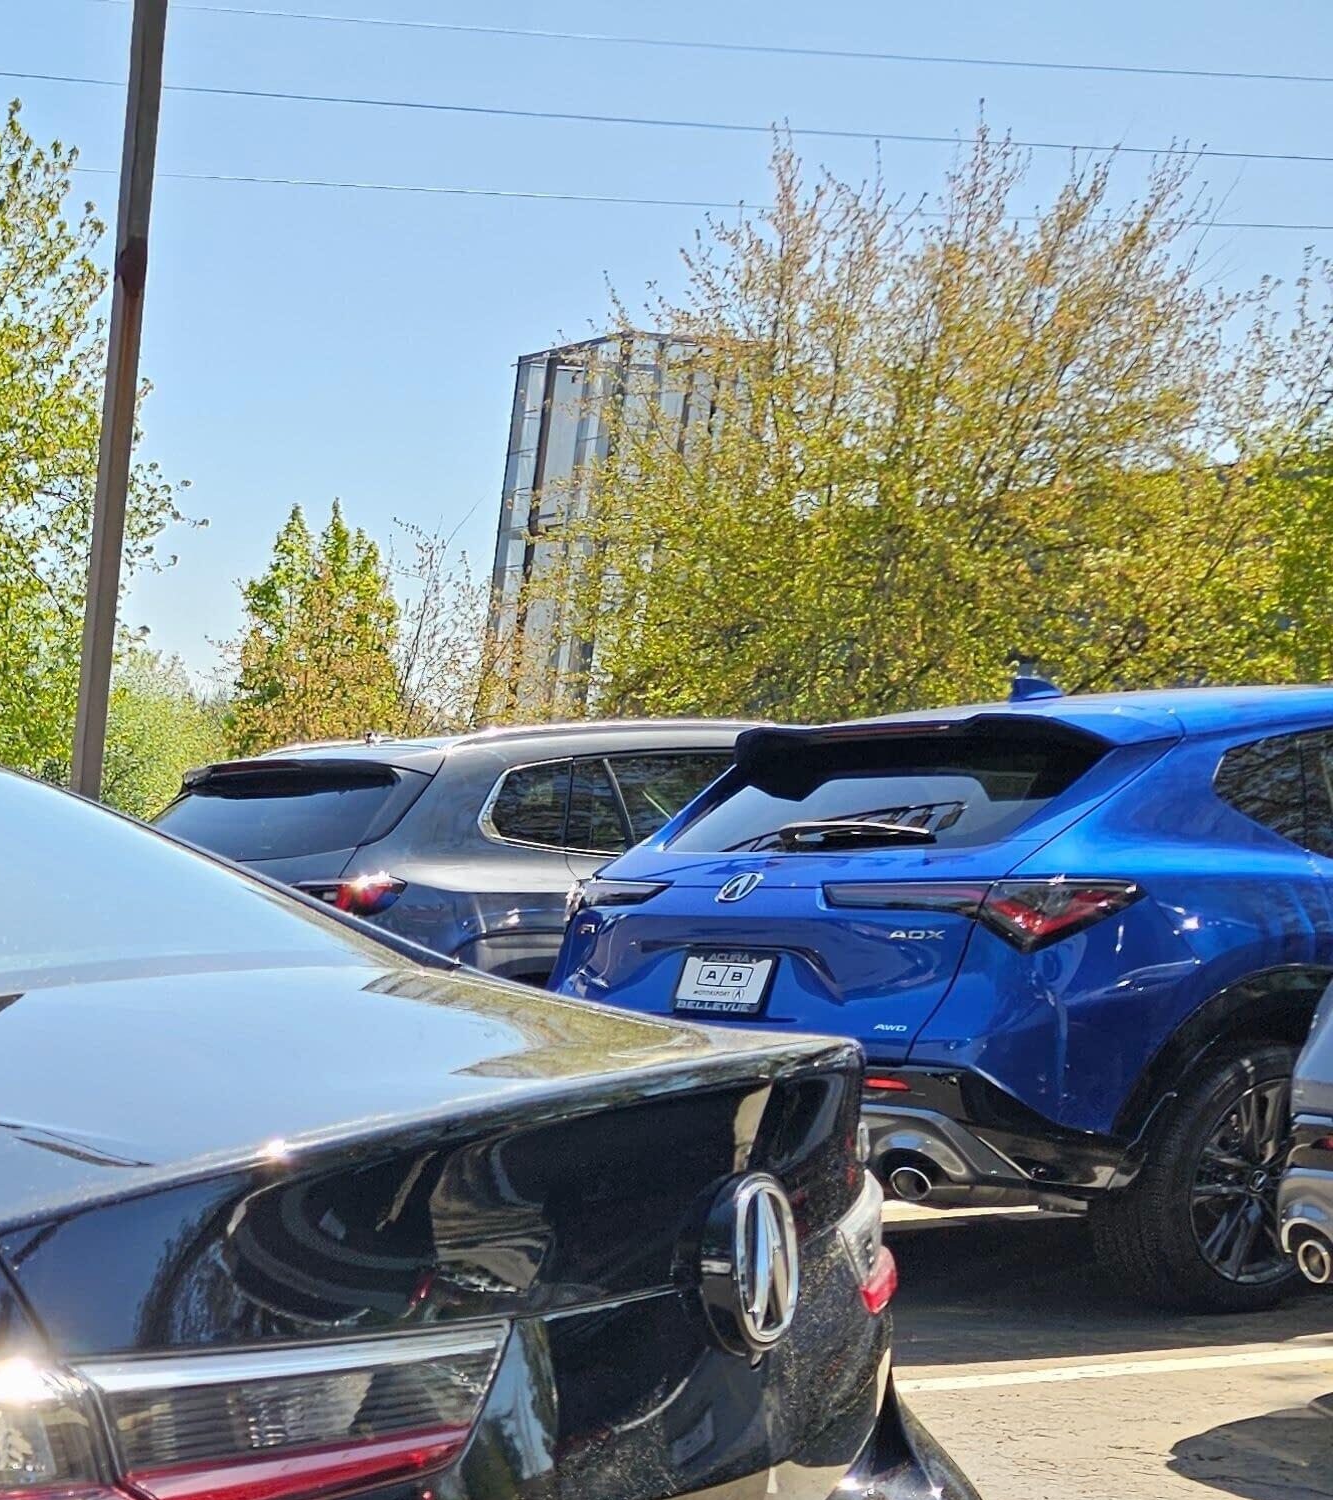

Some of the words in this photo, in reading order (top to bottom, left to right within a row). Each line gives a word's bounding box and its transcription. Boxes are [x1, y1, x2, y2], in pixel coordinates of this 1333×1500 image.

[889, 929, 946, 941] ADX
[708, 953, 750, 963] ACURA
[705, 970, 717, 979] A
[730, 972, 743, 981] B
[676, 1000, 750, 1012] BELLEVUE
[873, 1023, 908, 1032] AWD
